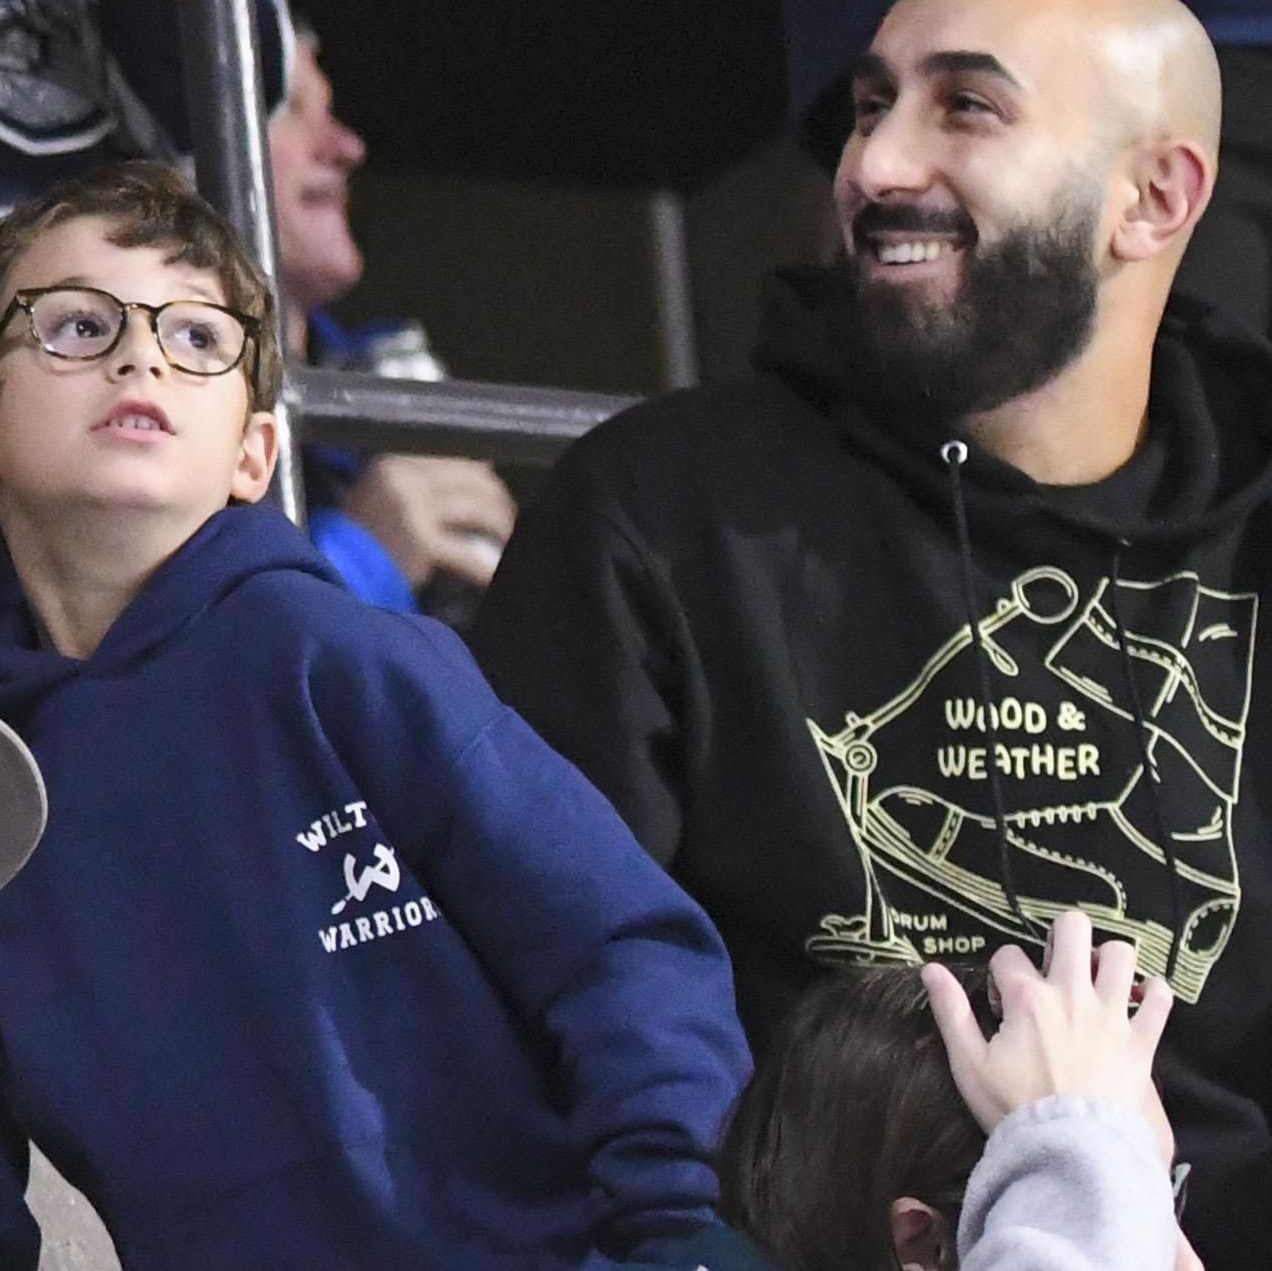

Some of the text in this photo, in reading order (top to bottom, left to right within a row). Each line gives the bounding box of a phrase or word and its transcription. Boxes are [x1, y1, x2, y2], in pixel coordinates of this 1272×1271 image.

[945, 696, 1086, 734] WOOD &
[938, 742, 1101, 781] WEATHER
[295, 800, 371, 853] WILT
[318, 895, 443, 954] WARRIOR
[922, 934, 986, 955] SHOP
